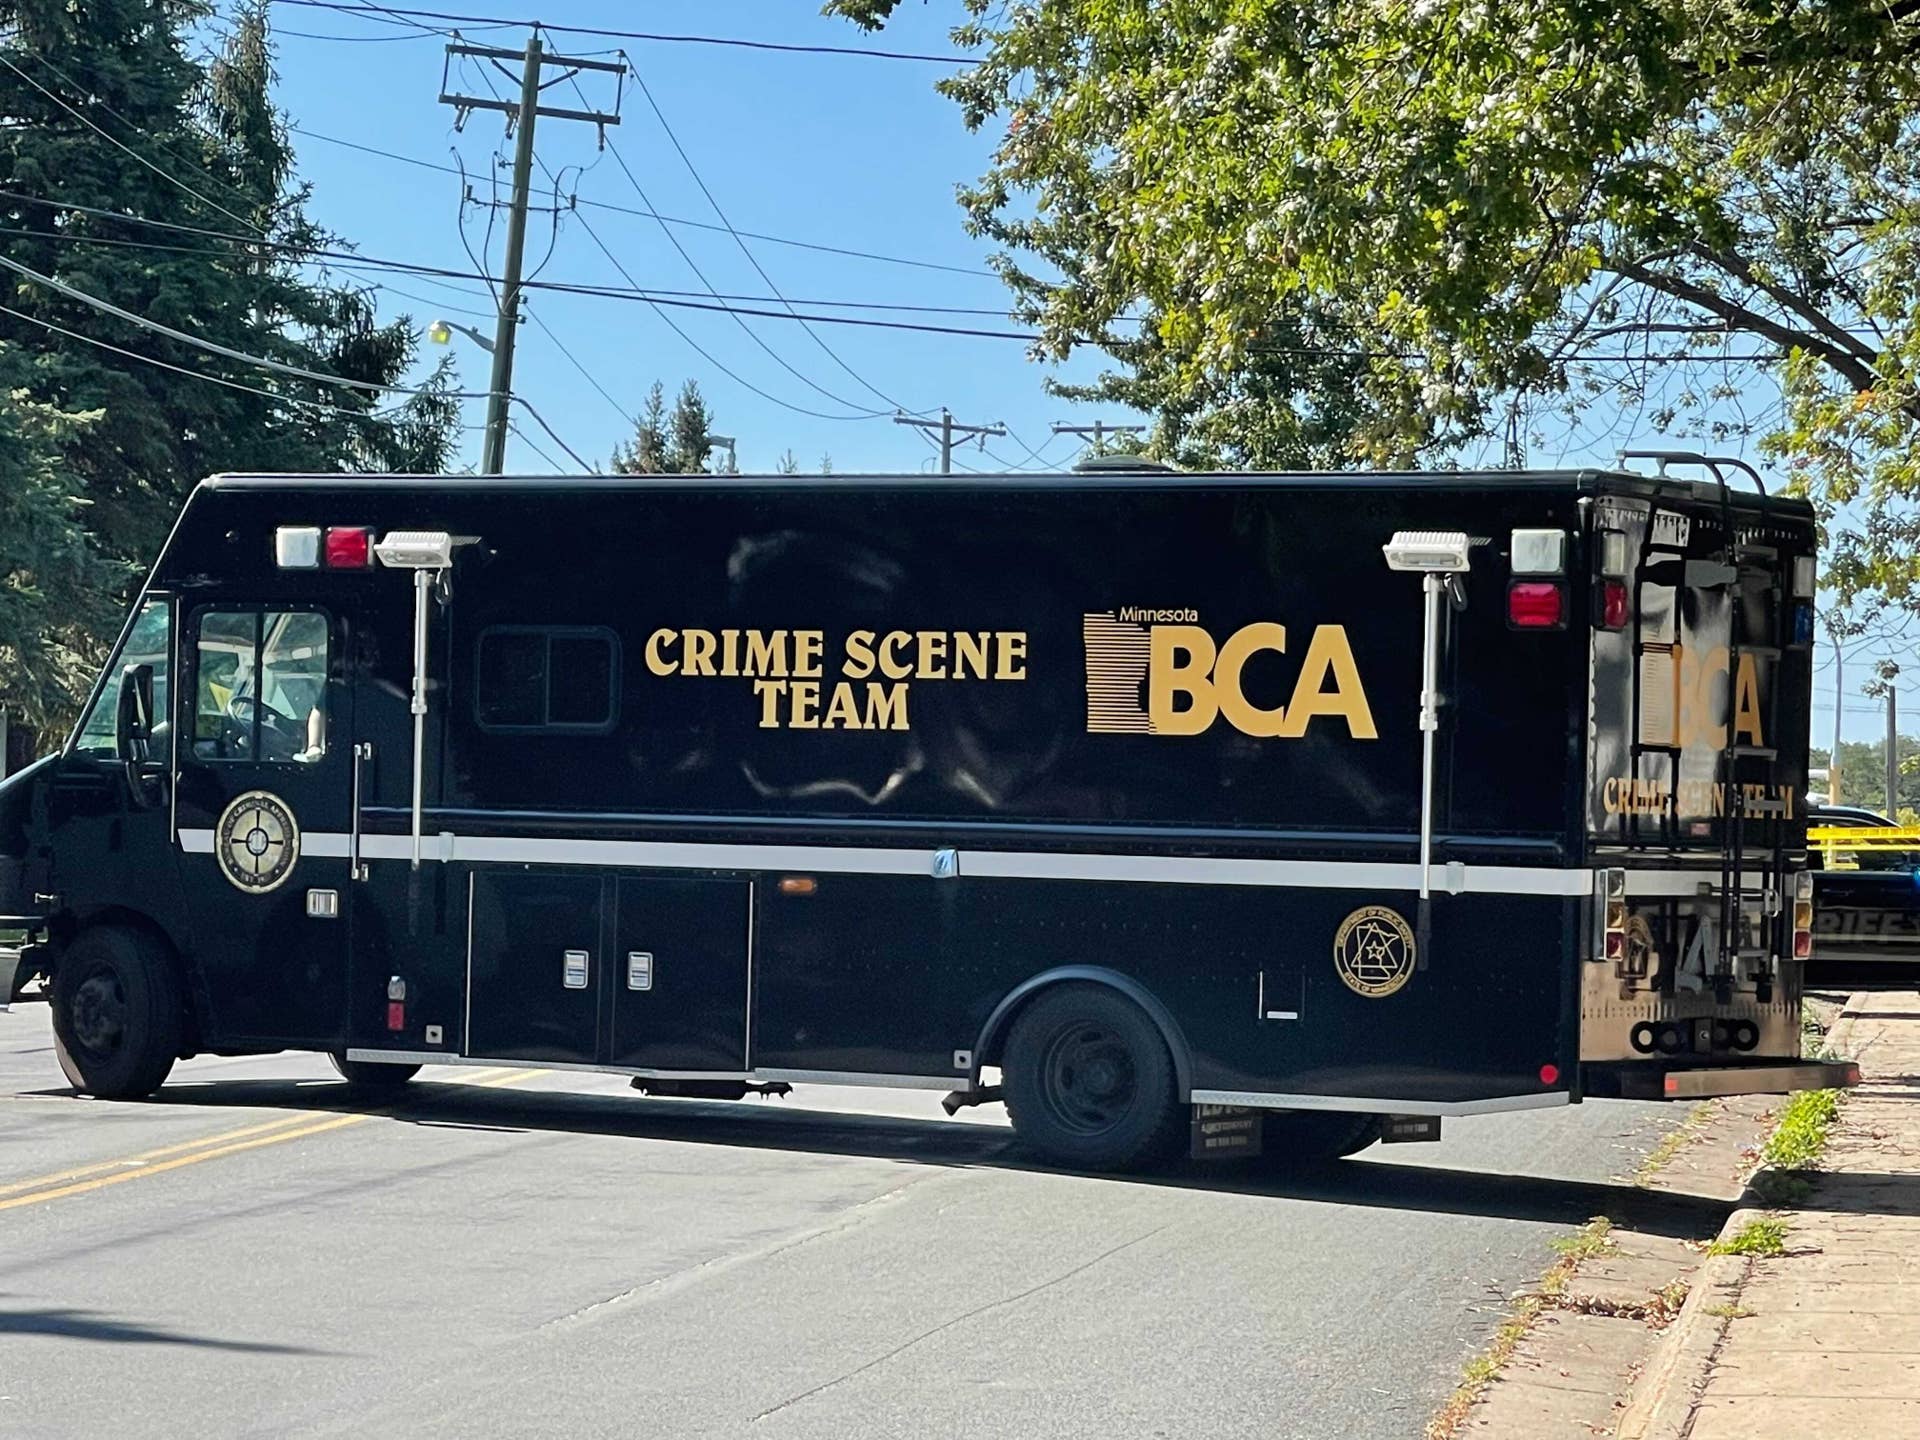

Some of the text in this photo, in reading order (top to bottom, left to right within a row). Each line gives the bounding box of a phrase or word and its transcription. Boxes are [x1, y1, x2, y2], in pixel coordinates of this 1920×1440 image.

[1118, 606, 1199, 622] Minnesota
[644, 627, 1028, 680] CRIME SCENE
[753, 679, 911, 731] TEAM
[1148, 622, 1379, 739] BCA
